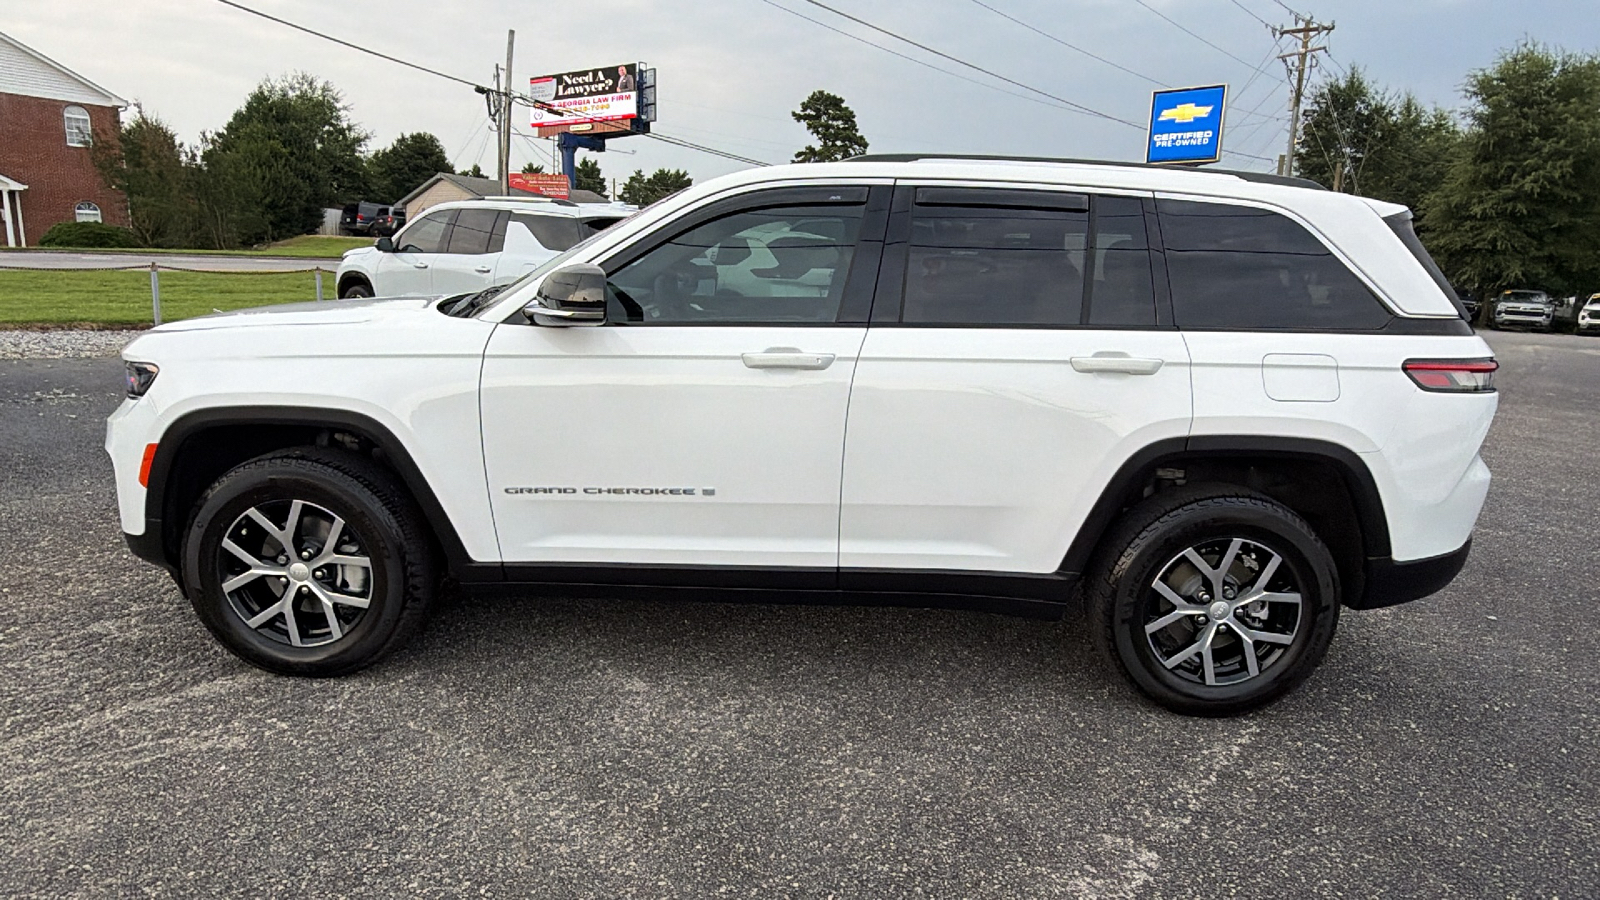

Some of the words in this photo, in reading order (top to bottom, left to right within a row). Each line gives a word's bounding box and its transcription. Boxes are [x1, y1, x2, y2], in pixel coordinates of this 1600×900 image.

[562, 72, 593, 84] Need
[596, 70, 605, 80] A
[558, 79, 613, 96] Lawyer?
[557, 99, 591, 108] GEORGIA
[611, 94, 632, 102] FIRM
[1154, 131, 1212, 141] CERTIFIED
[1156, 138, 1209, 147] PRE-OWNED
[583, 487, 696, 495] CHEROKEE
